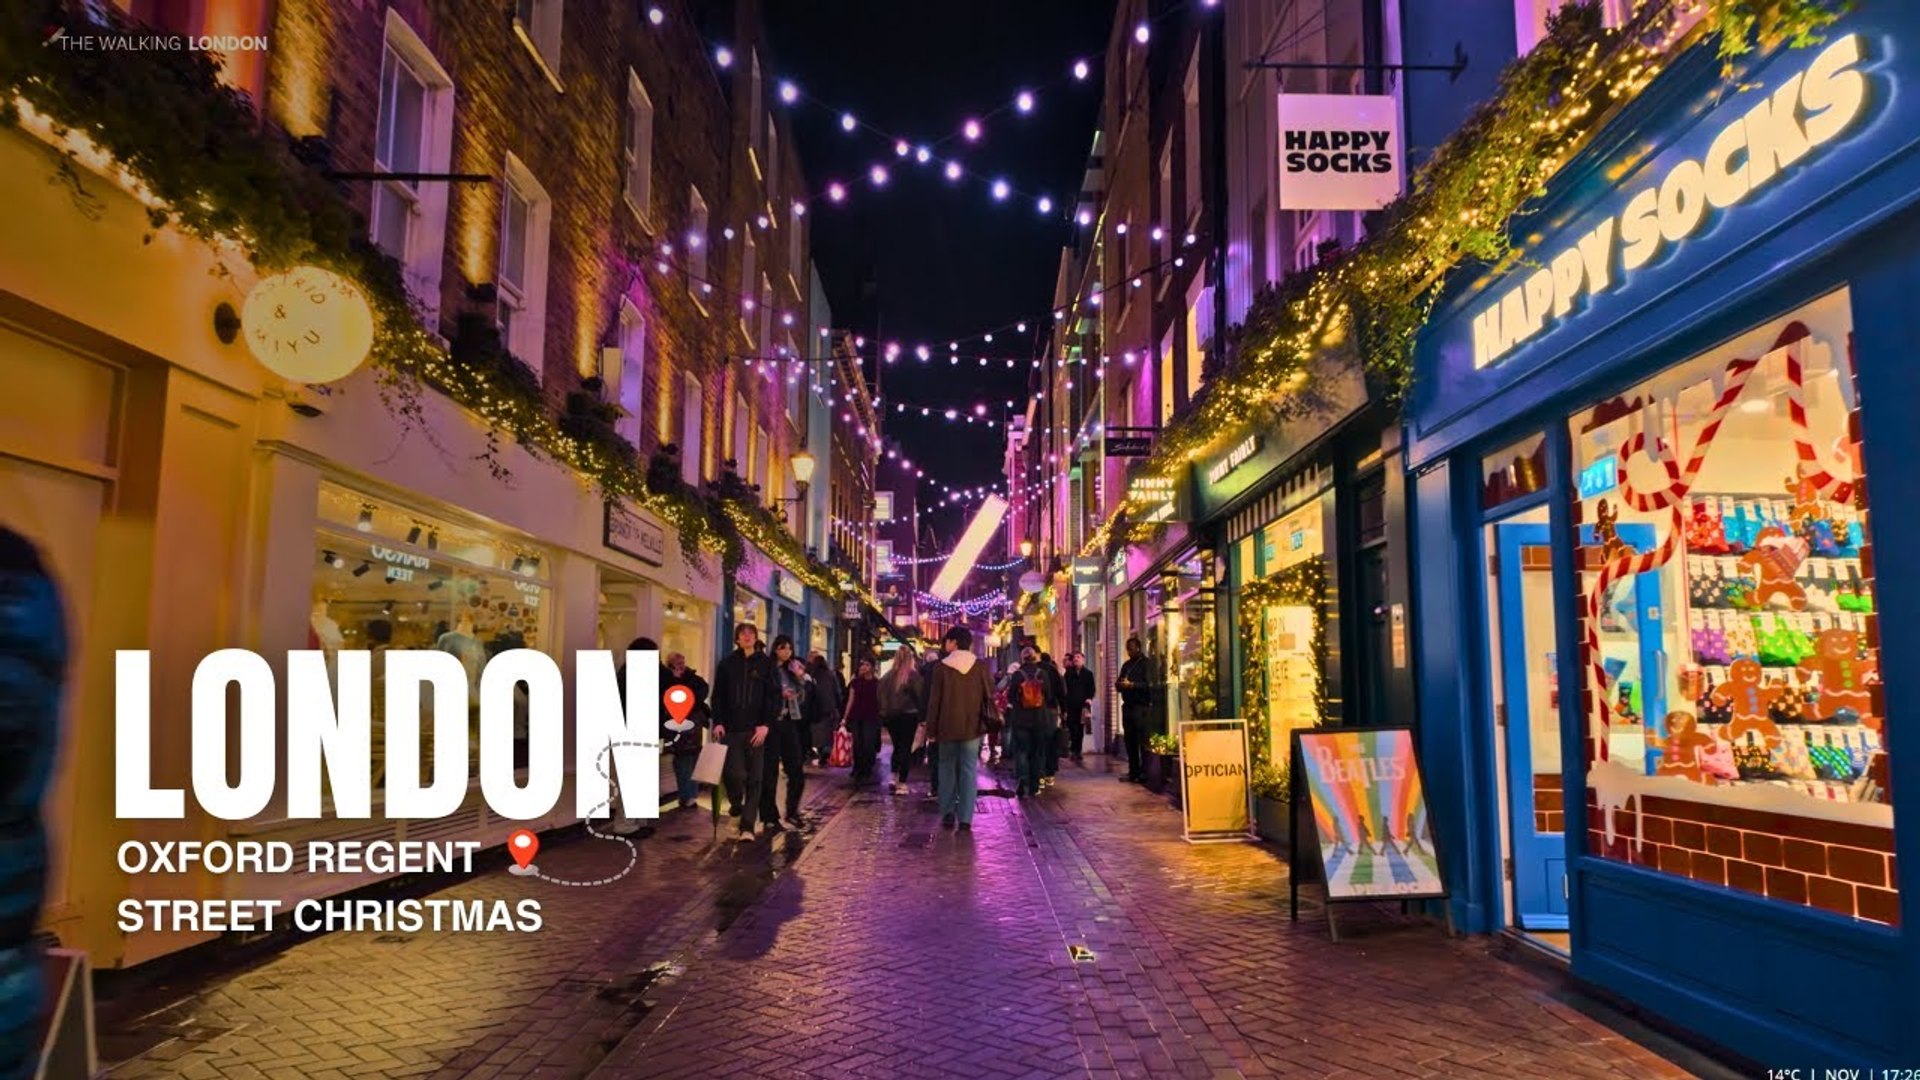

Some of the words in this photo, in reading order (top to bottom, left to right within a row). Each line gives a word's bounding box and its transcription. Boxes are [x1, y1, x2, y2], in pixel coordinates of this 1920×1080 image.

[1284, 131, 1390, 150] HAPPY
[1286, 152, 1392, 173] SOCKS
[1473, 216, 1614, 370] HAPPY
[1620, 34, 1867, 270] SOCKS
[274, 304, 286, 319] &
[1317, 746, 1406, 789] BEATLES
